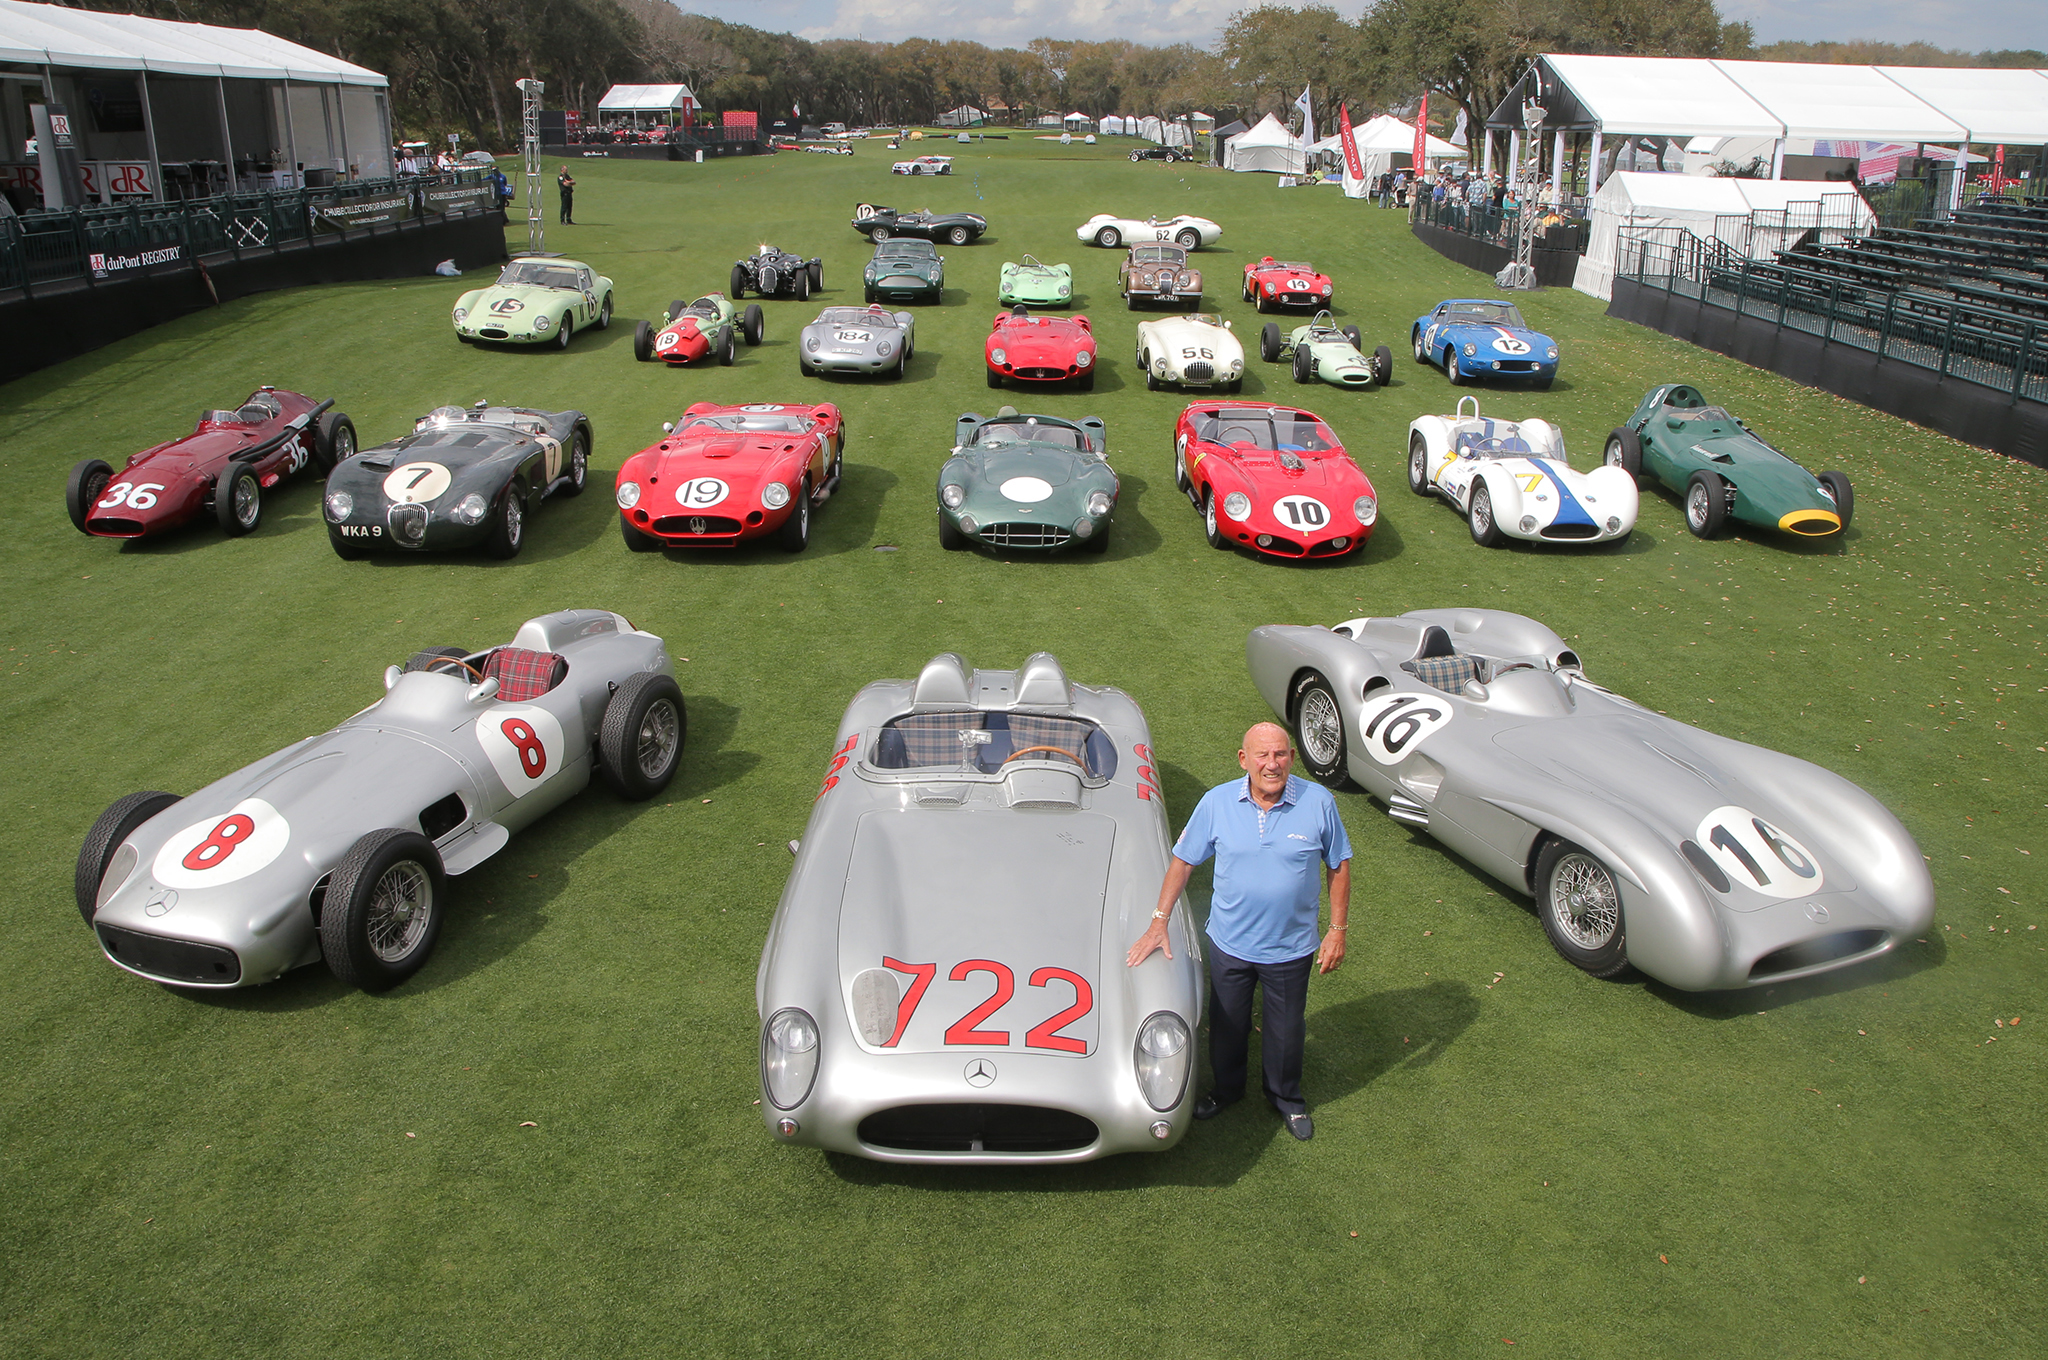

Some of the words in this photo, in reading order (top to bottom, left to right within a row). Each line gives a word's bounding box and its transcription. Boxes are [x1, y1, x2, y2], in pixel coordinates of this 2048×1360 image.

[1343, 128, 1358, 172] JAGUAR
[860, 206, 871, 217] 12
[1156, 230, 1170, 241] 62
[106, 255, 141, 271] duPont
[141, 246, 180, 266] REGISTRY
[1292, 280, 1307, 289] 14
[492, 299, 521, 313] 15
[660, 335, 674, 346] 18
[838, 331, 872, 342] 184
[1500, 340, 1526, 352] 12
[1649, 387, 1666, 409] 8
[282, 434, 308, 474] 36
[547, 442, 557, 476] 7
[1434, 450, 1458, 482] 7
[406, 467, 433, 490] 7
[1515, 473, 1544, 492] 7
[97, 482, 165, 510] 36
[683, 480, 723, 503] 19
[1282, 501, 1325, 525] 10
[341, 525, 370, 537] WKA
[372, 525, 382, 537] 9
[1365, 697, 1442, 754] 16
[501, 718, 546, 779] 8
[182, 813, 255, 871] 8
[1709, 817, 1817, 887] 16
[880, 956, 1093, 1055] 722
